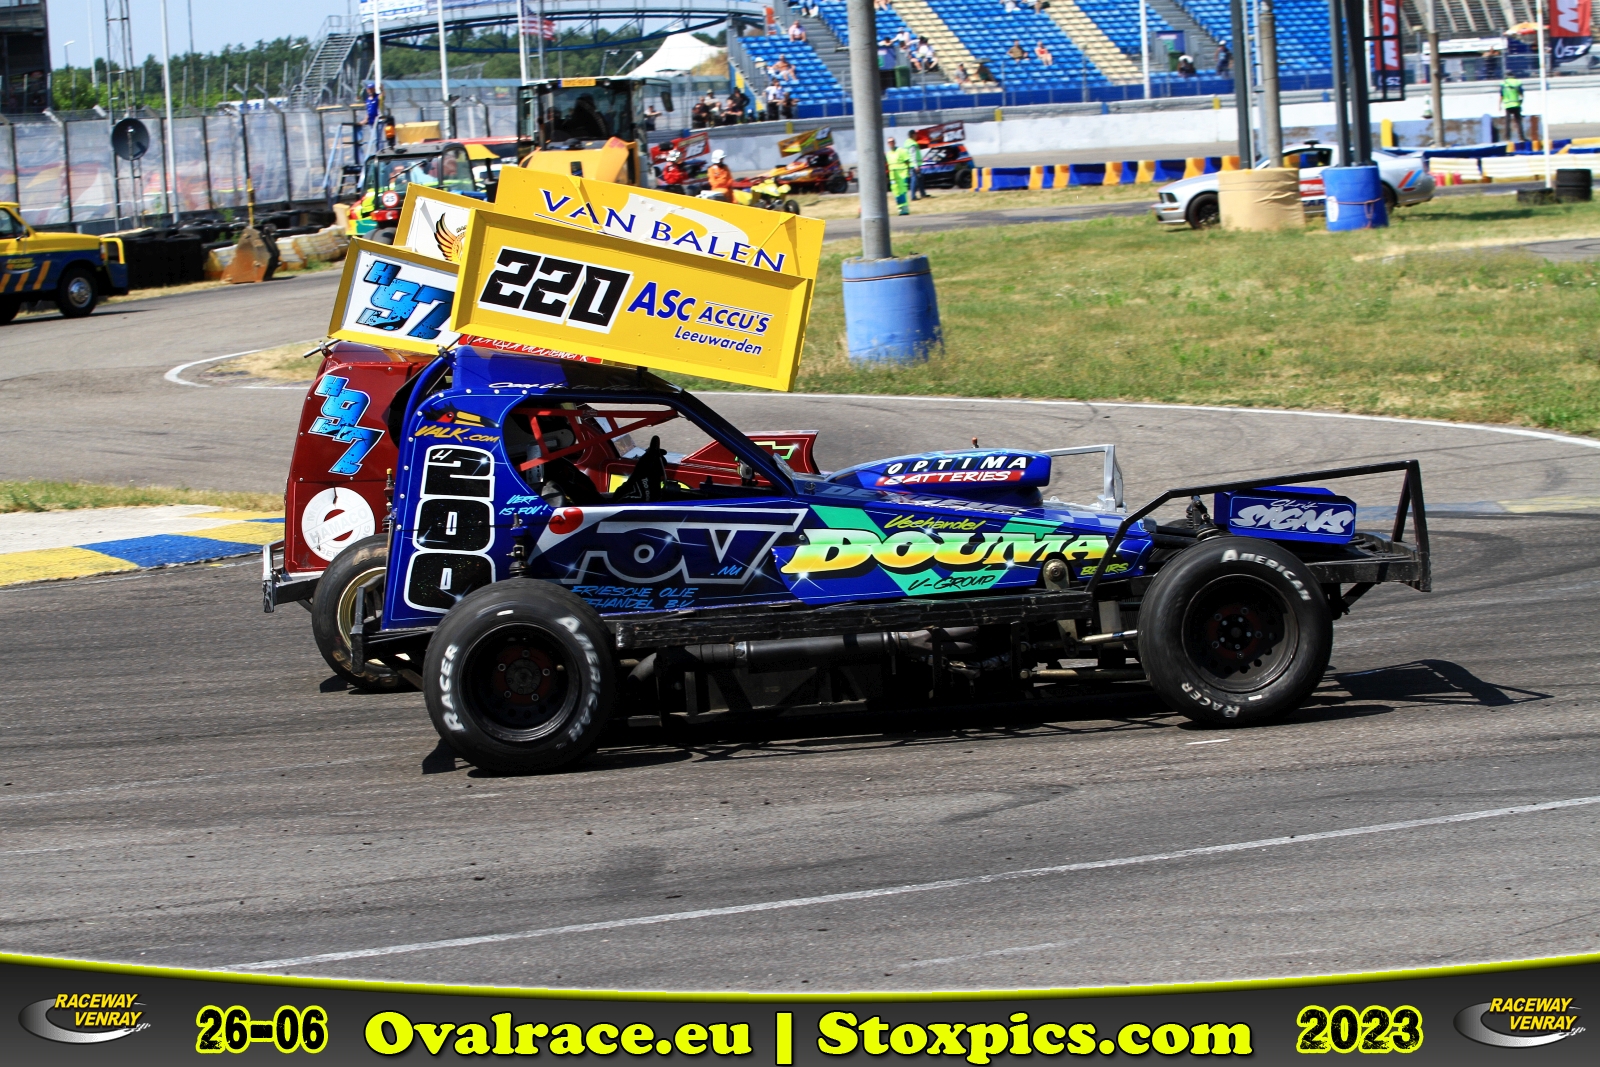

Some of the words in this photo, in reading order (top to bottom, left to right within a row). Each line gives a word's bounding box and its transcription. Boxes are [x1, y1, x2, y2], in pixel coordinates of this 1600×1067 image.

[542, 190, 636, 233] VAN
[651, 221, 786, 272] BALEN
[480, 247, 630, 328] 220
[627, 281, 697, 322] ASC
[698, 306, 770, 333] ACCU'S
[674, 325, 763, 355] Leeuwarden
[883, 470, 1012, 486] BATTERIES
[887, 455, 1028, 475] OPTIMA
[309, 507, 369, 544] HAMACO
[404, 444, 495, 614] 200
[1230, 504, 1355, 534] SIGNS
[780, 528, 1118, 574] DOUMA
[571, 585, 653, 598] FRIESCHE
[659, 587, 699, 598] OLIE
[908, 575, 996, 591] V-GROUP
[439, 644, 466, 732] RACER
